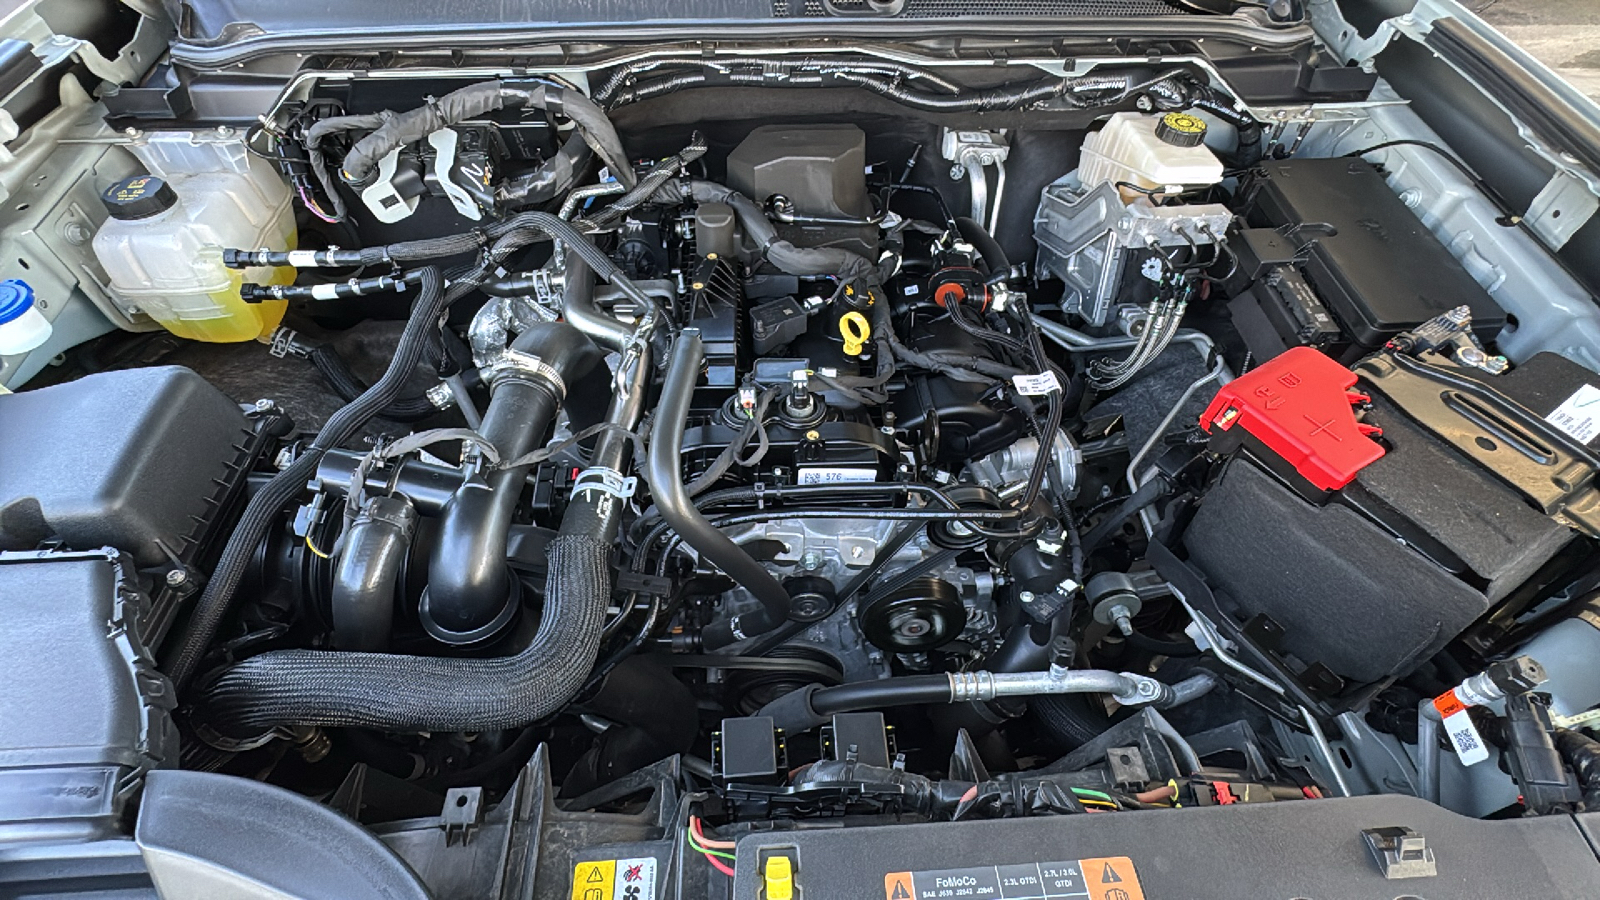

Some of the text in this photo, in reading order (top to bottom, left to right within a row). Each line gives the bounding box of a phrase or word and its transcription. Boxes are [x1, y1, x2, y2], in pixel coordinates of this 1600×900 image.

[826, 472, 842, 480] 576
[936, 876, 977, 888] FoMoCo
[1004, 878, 1019, 886] 2.3L
